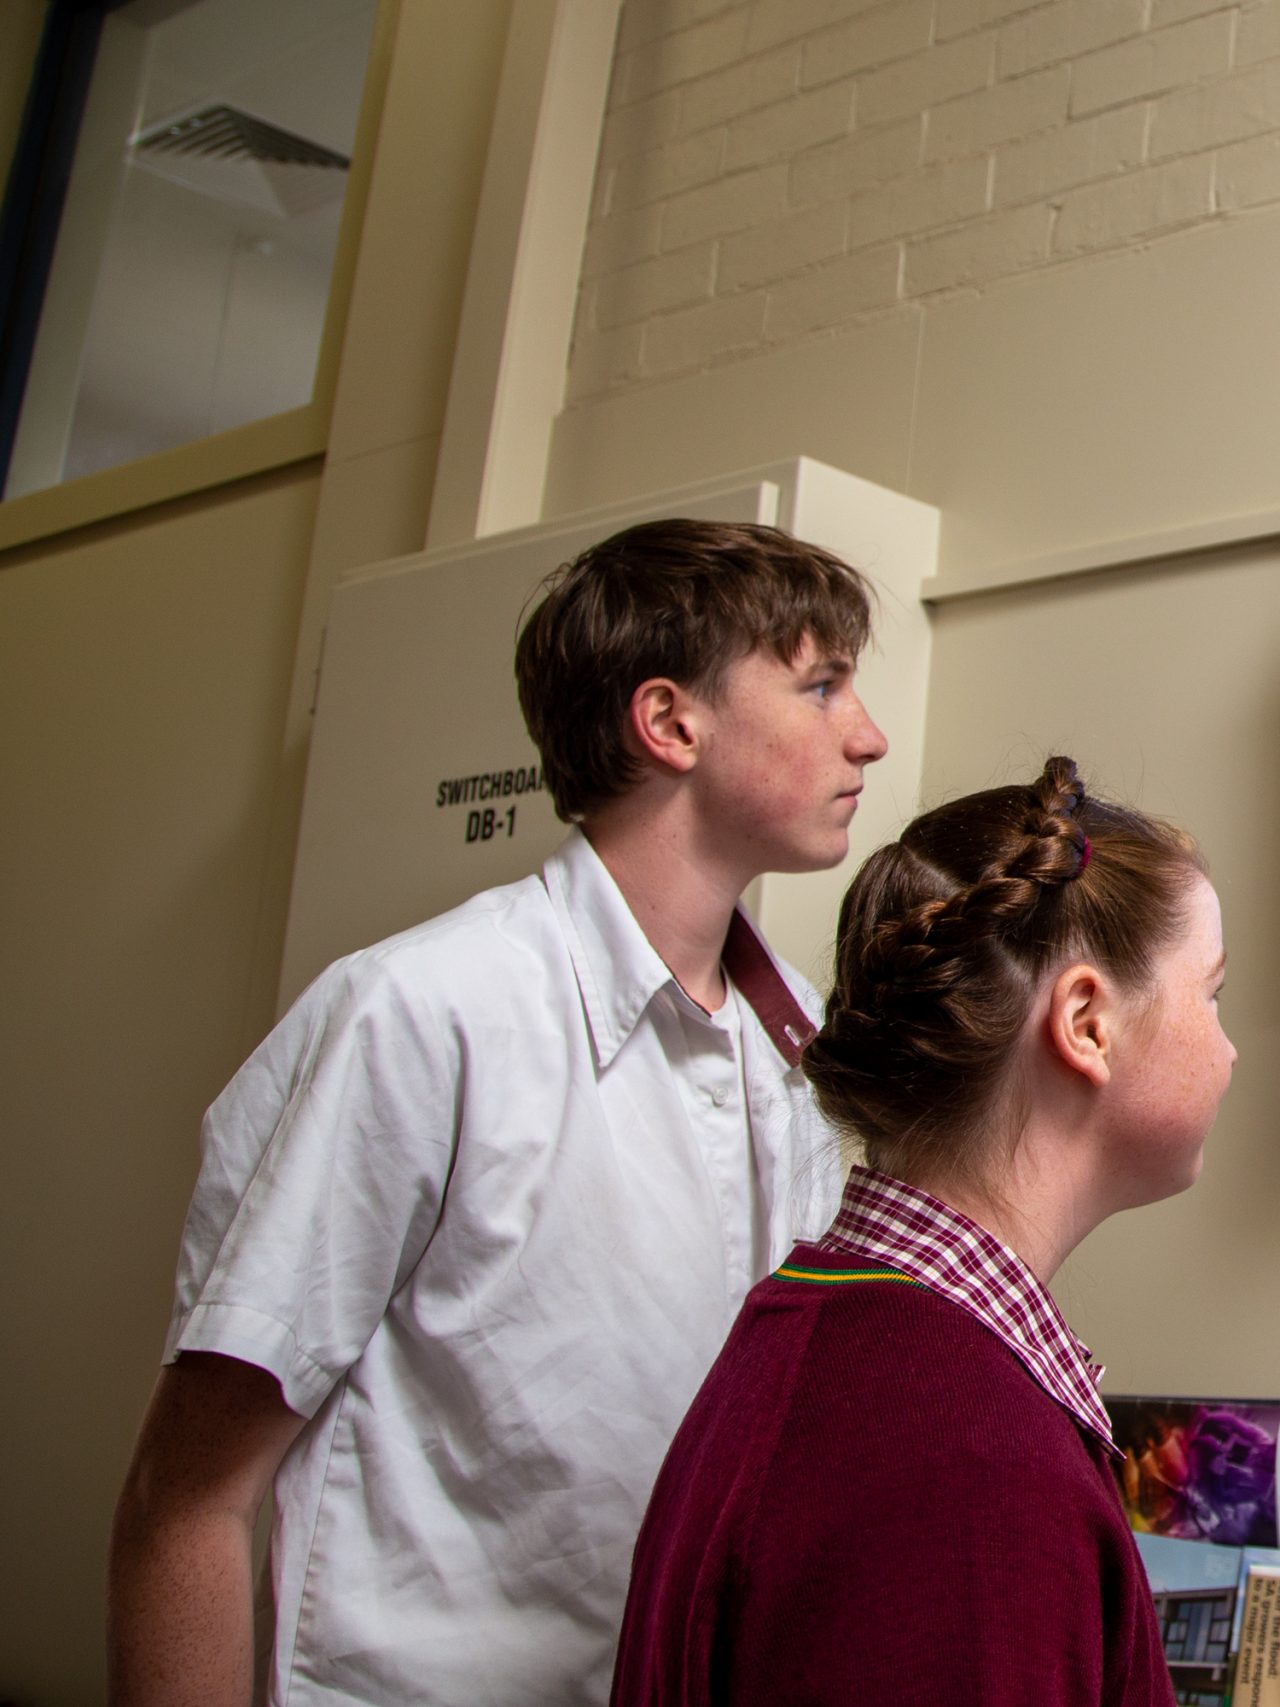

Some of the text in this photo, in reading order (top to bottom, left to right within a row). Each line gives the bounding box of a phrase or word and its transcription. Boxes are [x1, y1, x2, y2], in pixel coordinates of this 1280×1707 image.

[465, 804, 516, 844] DB-1
[1254, 1578, 1263, 1591] to
[1246, 1607, 1258, 1643] major
[1257, 1601, 1271, 1653] growers
[1240, 1648, 1252, 1684] event
